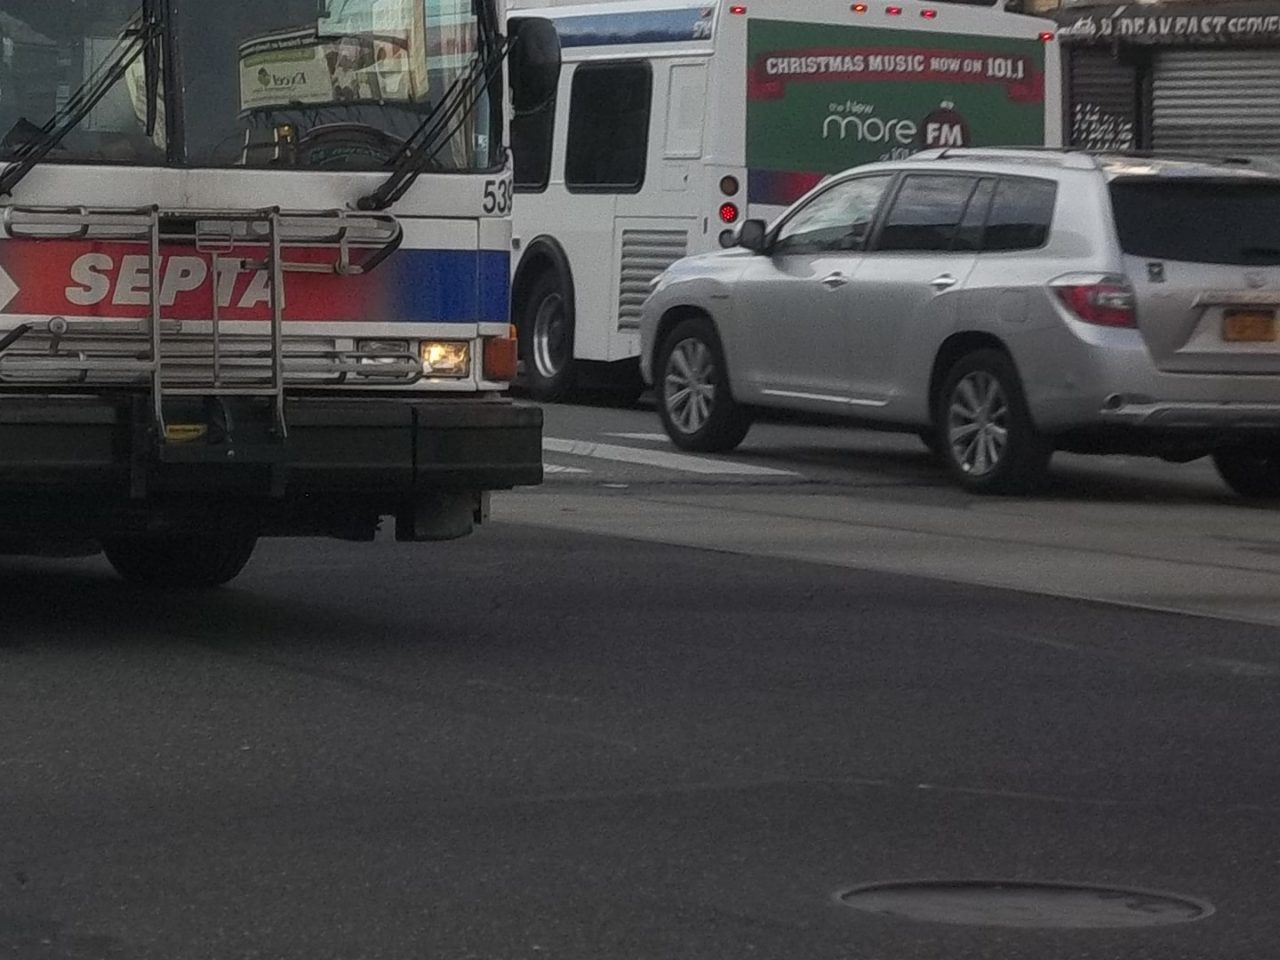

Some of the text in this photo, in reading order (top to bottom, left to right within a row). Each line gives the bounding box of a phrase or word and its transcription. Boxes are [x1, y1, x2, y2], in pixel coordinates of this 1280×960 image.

[765, 54, 1025, 80] CHRISTMAS MUSIC NOW ON 101.1
[822, 114, 964, 147] more FM
[64, 252, 286, 309] SEPTA
